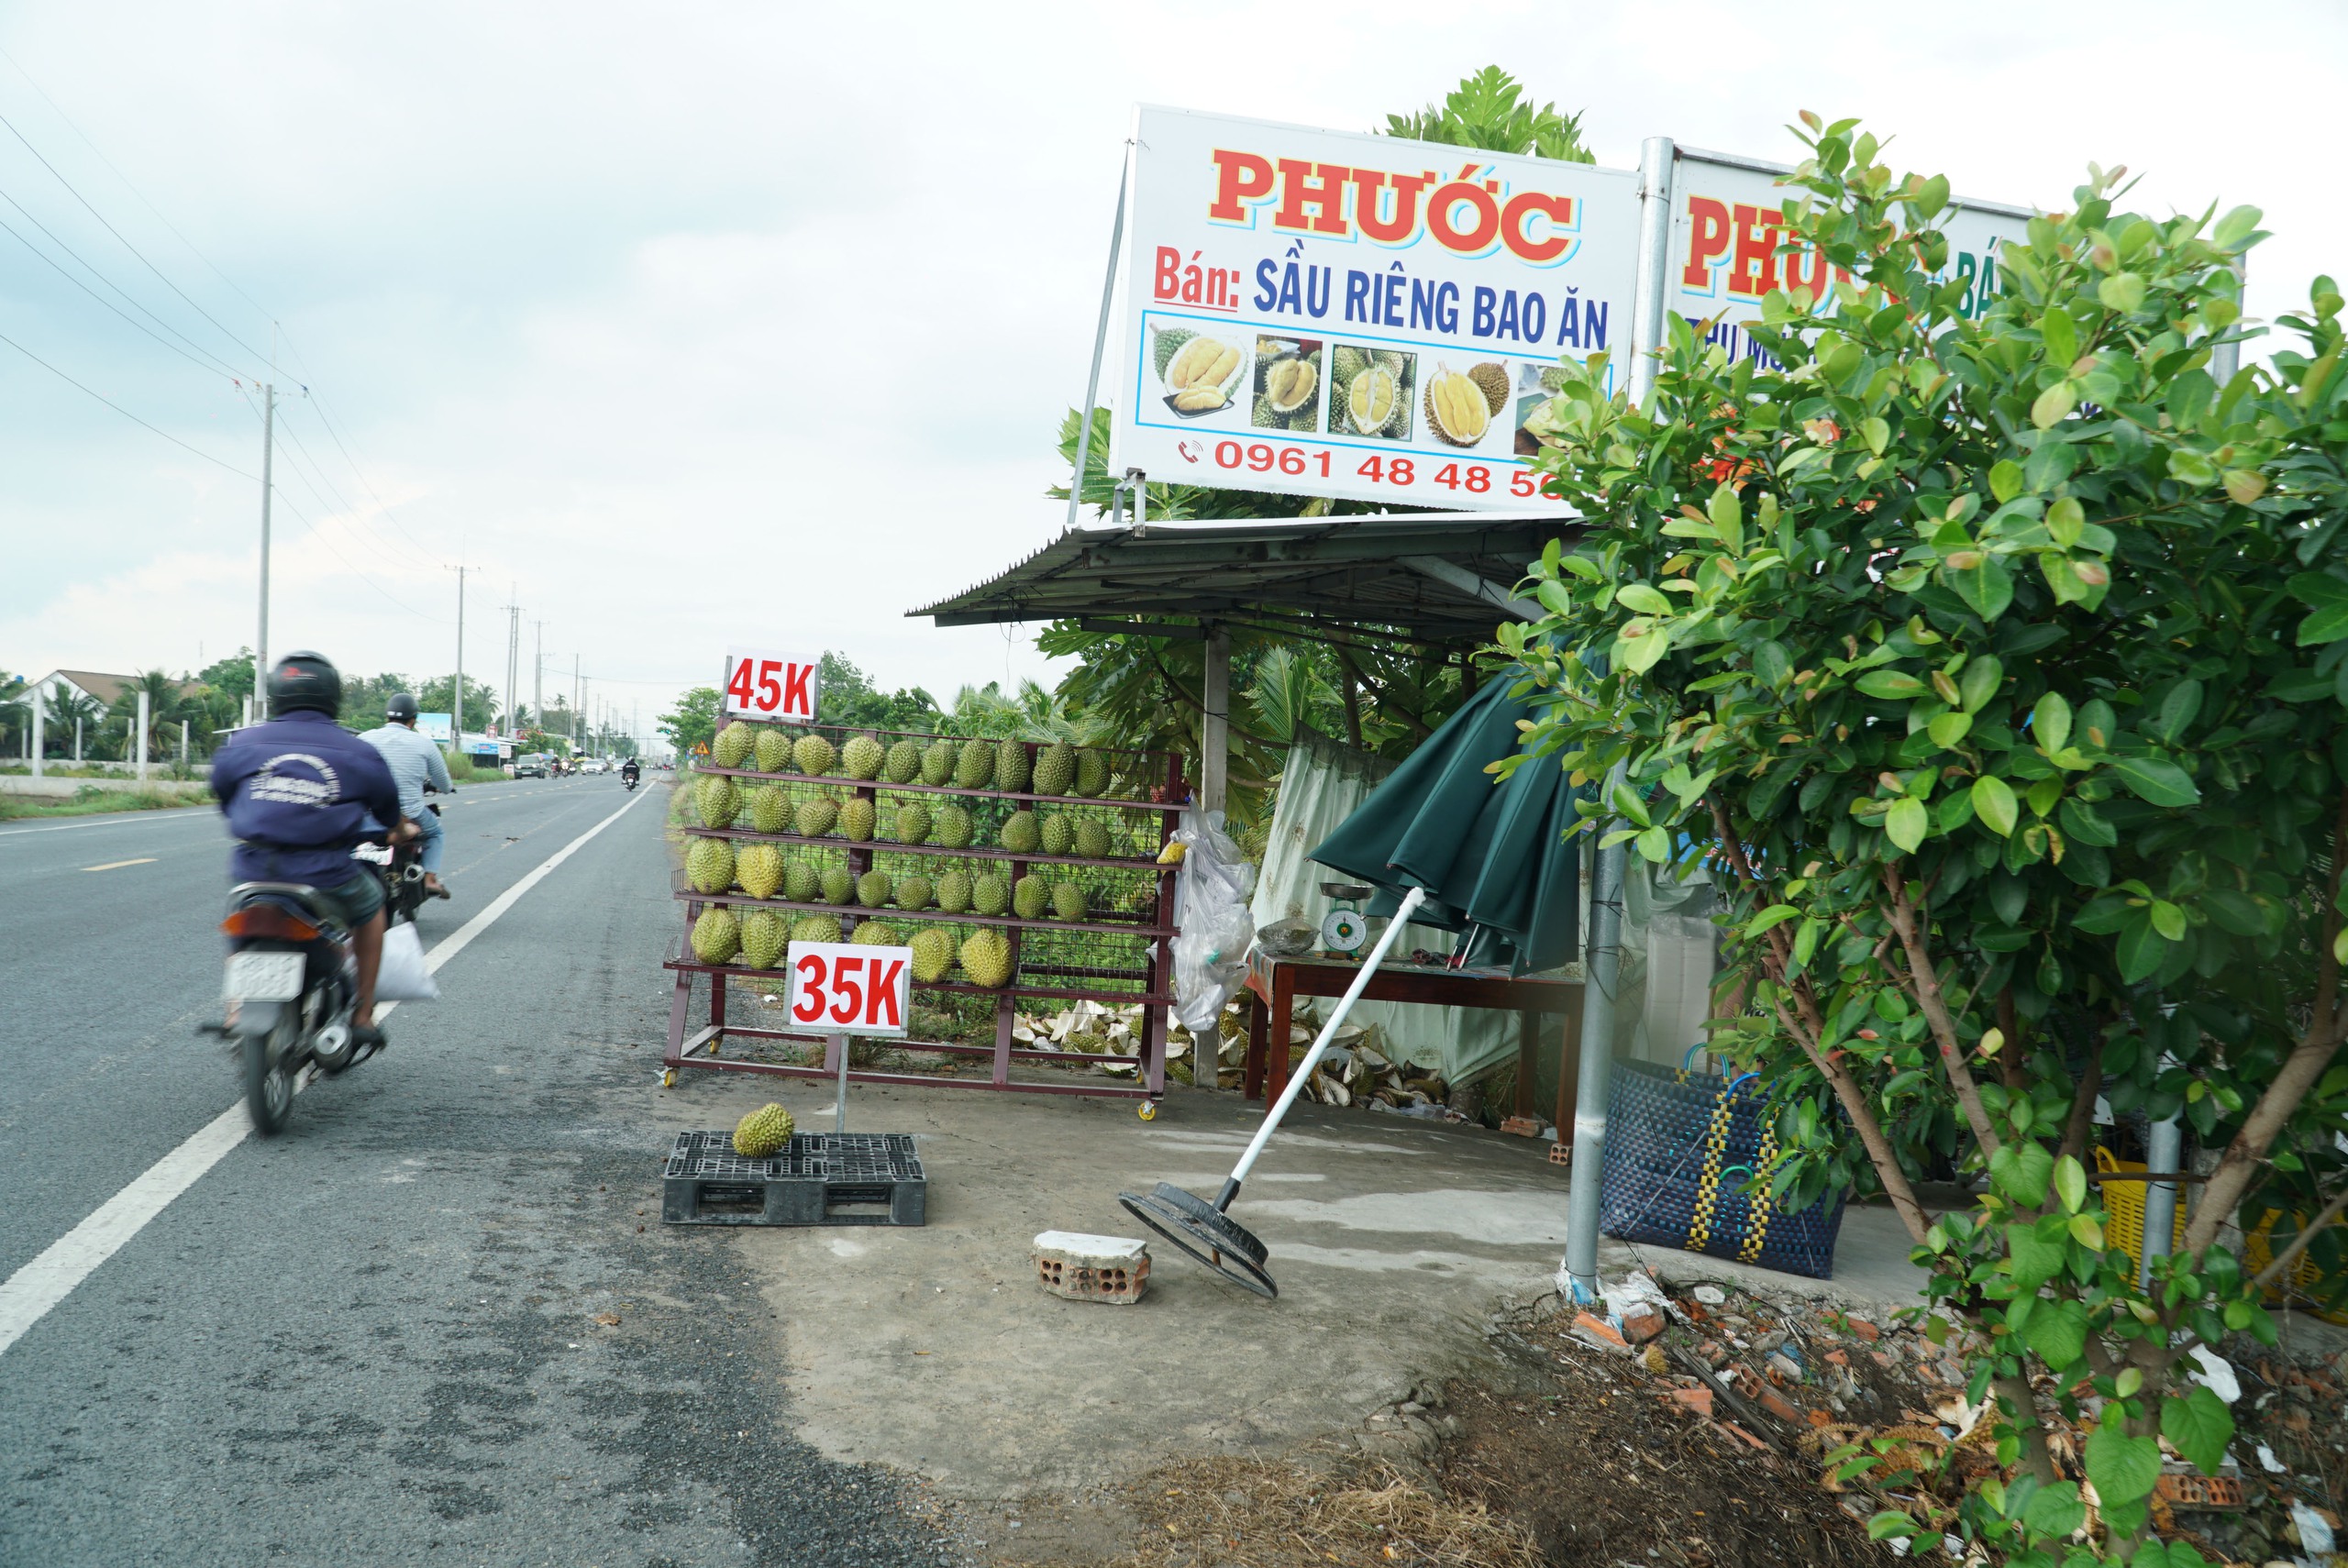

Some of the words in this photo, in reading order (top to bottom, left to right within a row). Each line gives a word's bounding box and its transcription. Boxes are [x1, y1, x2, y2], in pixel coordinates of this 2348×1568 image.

[1210, 149, 1572, 261] PHƯỚC
[1154, 246, 1240, 309] Bán:
[1254, 237, 1332, 319] SẦU
[1345, 260, 1460, 337] RIÊNG
[1472, 285, 1546, 345] BAO
[1556, 285, 1610, 351] ĂN
[1956, 235, 2008, 321] BÁ
[1214, 440, 1332, 478] 0961
[1357, 454, 1415, 487] 48
[1434, 462, 1492, 494] 48
[727, 657, 815, 716] 45K
[792, 954, 905, 1027] 35K
